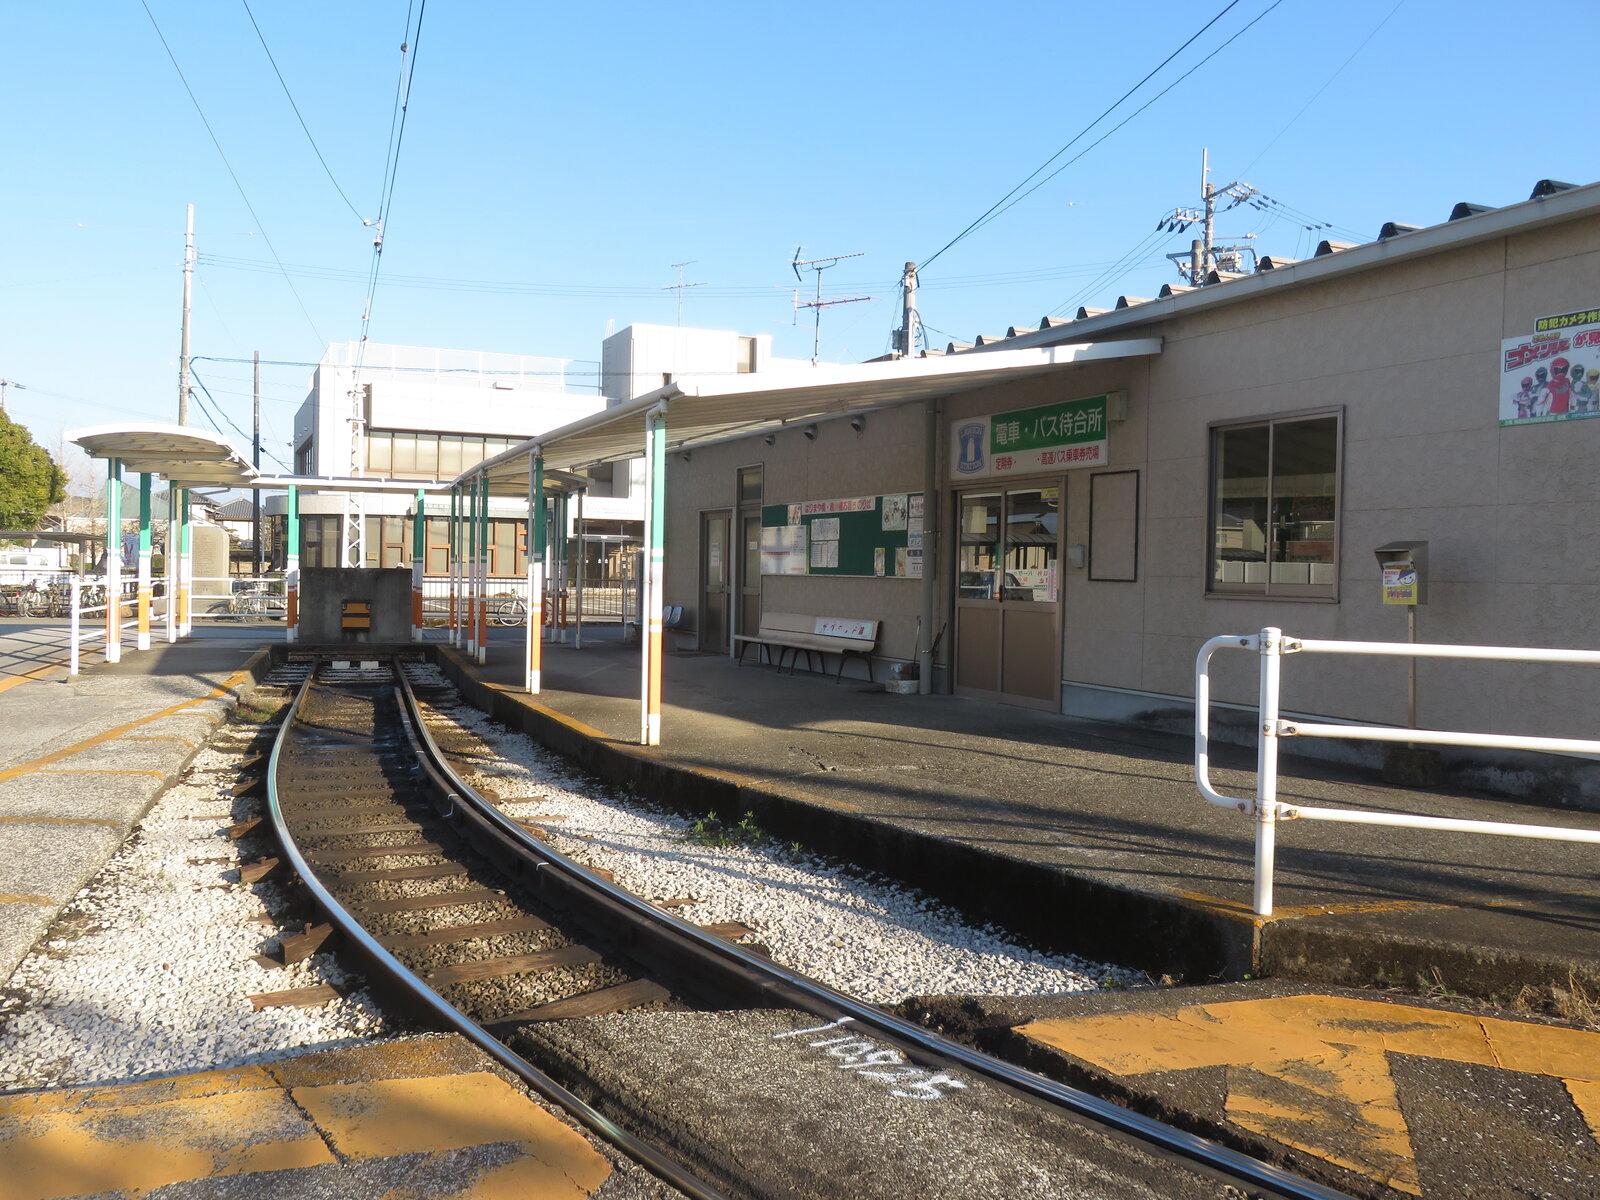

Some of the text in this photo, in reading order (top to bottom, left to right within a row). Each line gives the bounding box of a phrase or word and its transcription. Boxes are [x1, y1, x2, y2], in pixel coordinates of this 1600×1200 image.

[1537, 310, 1600, 331] 防犯カメラ作
[996, 407, 1102, 445] 電車・バス待合所
